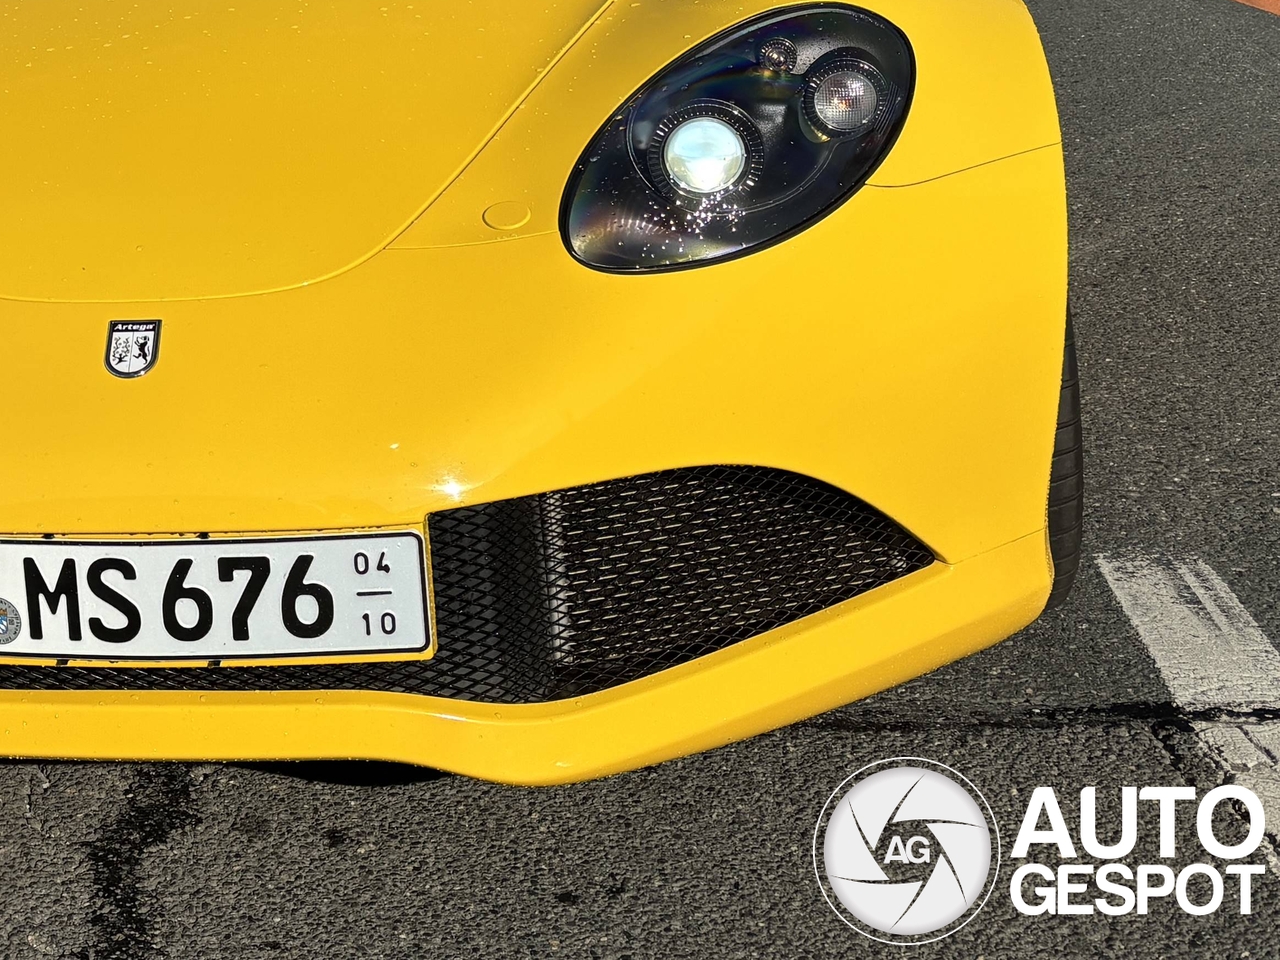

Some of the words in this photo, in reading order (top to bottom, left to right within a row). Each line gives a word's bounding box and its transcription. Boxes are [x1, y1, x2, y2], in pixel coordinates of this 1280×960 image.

[114, 323, 155, 331] Artega
[353, 552, 392, 575] 04
[22, 557, 141, 643] MS
[162, 554, 335, 642] 676
[362, 613, 397, 636] 10
